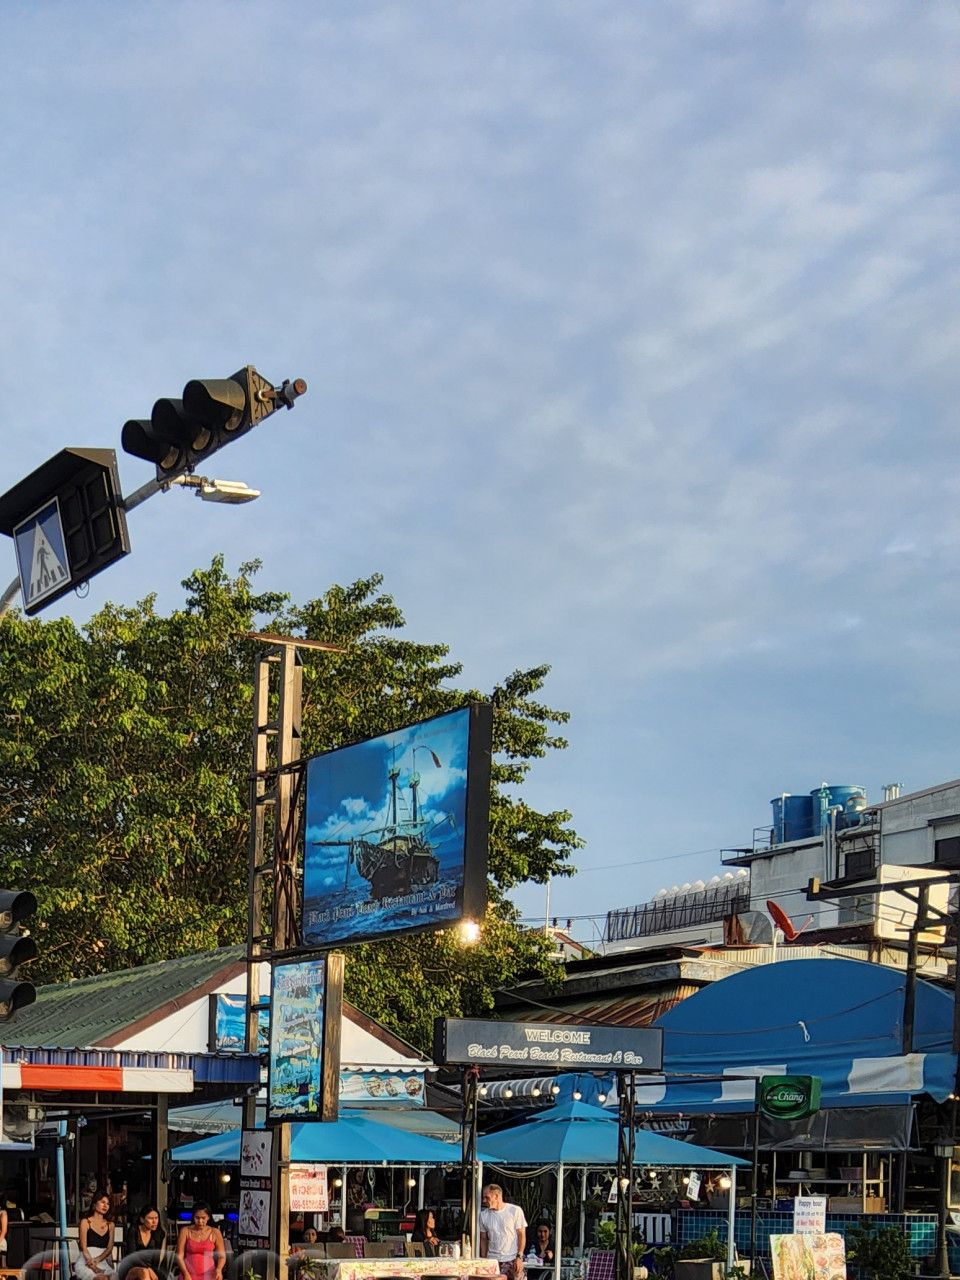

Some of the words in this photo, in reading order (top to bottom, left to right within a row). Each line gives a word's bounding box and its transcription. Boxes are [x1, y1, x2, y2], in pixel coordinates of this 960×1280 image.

[524, 1028, 591, 1044] WELCOME
[467, 1043, 498, 1059] Black
[499, 1045, 529, 1060] Pearl
[529, 1046, 560, 1062] Beach
[560, 1048, 612, 1064] Restaurant
[612, 1050, 622, 1064] &
[623, 1051, 643, 1065] Bar
[778, 1091, 804, 1104] Chang
